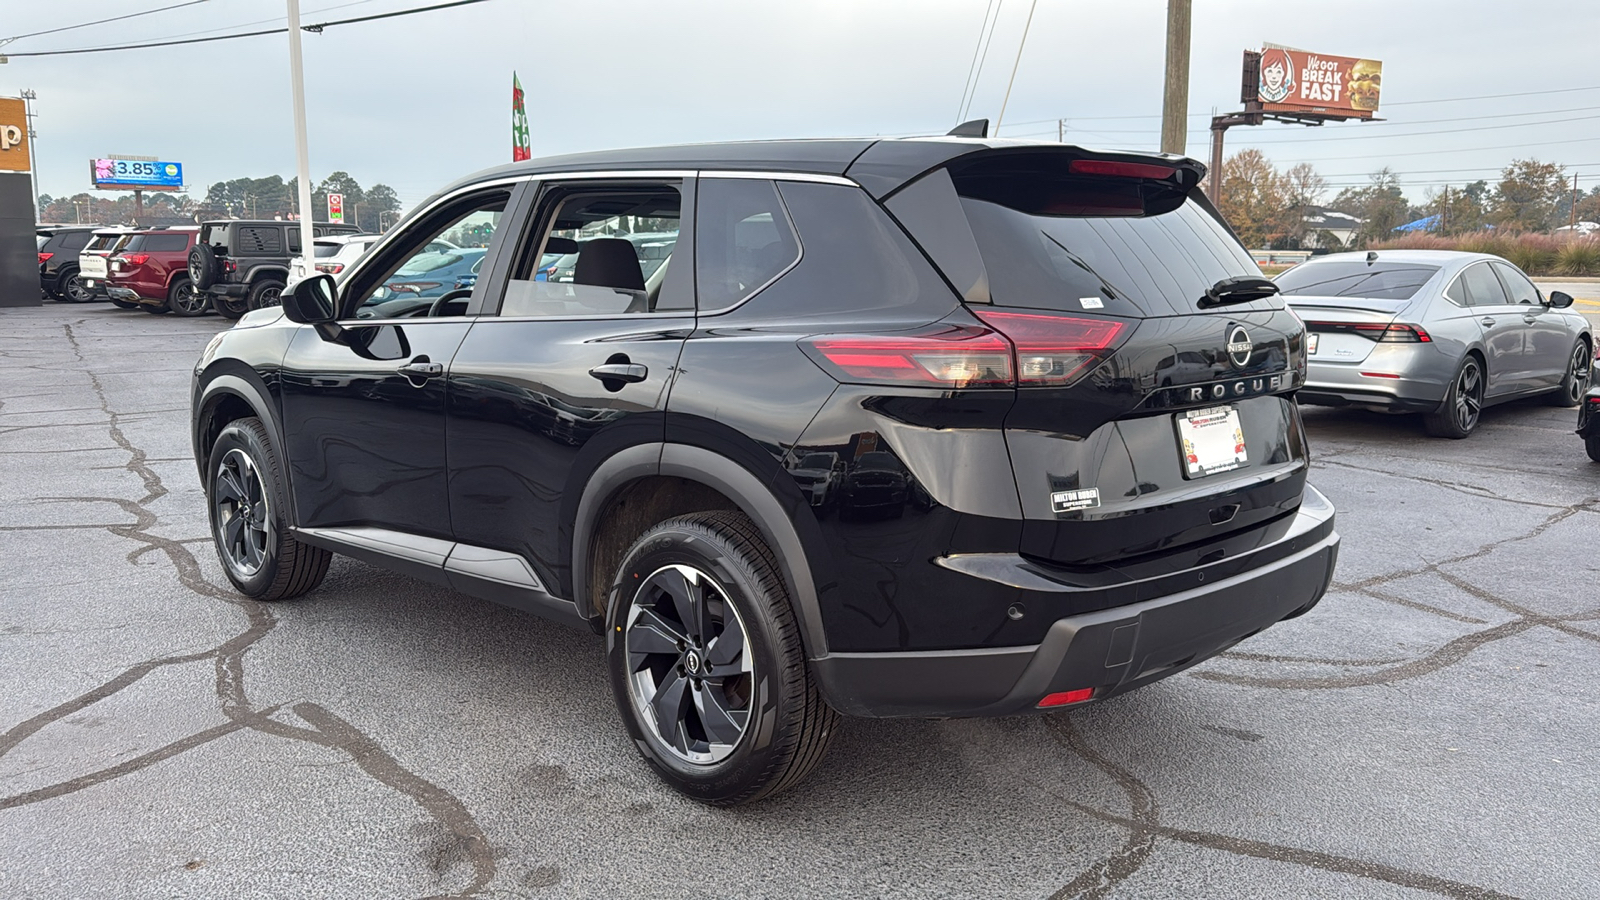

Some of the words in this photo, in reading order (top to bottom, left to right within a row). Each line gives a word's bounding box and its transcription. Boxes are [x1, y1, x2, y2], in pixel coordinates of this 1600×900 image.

[1307, 55, 1320, 71] We
[1320, 61, 1339, 72] GOT
[1302, 68, 1343, 84] BREAK
[1301, 82, 1343, 101] FAST
[1190, 376, 1280, 401] ROGUE
[1054, 491, 1077, 502] MILTON
